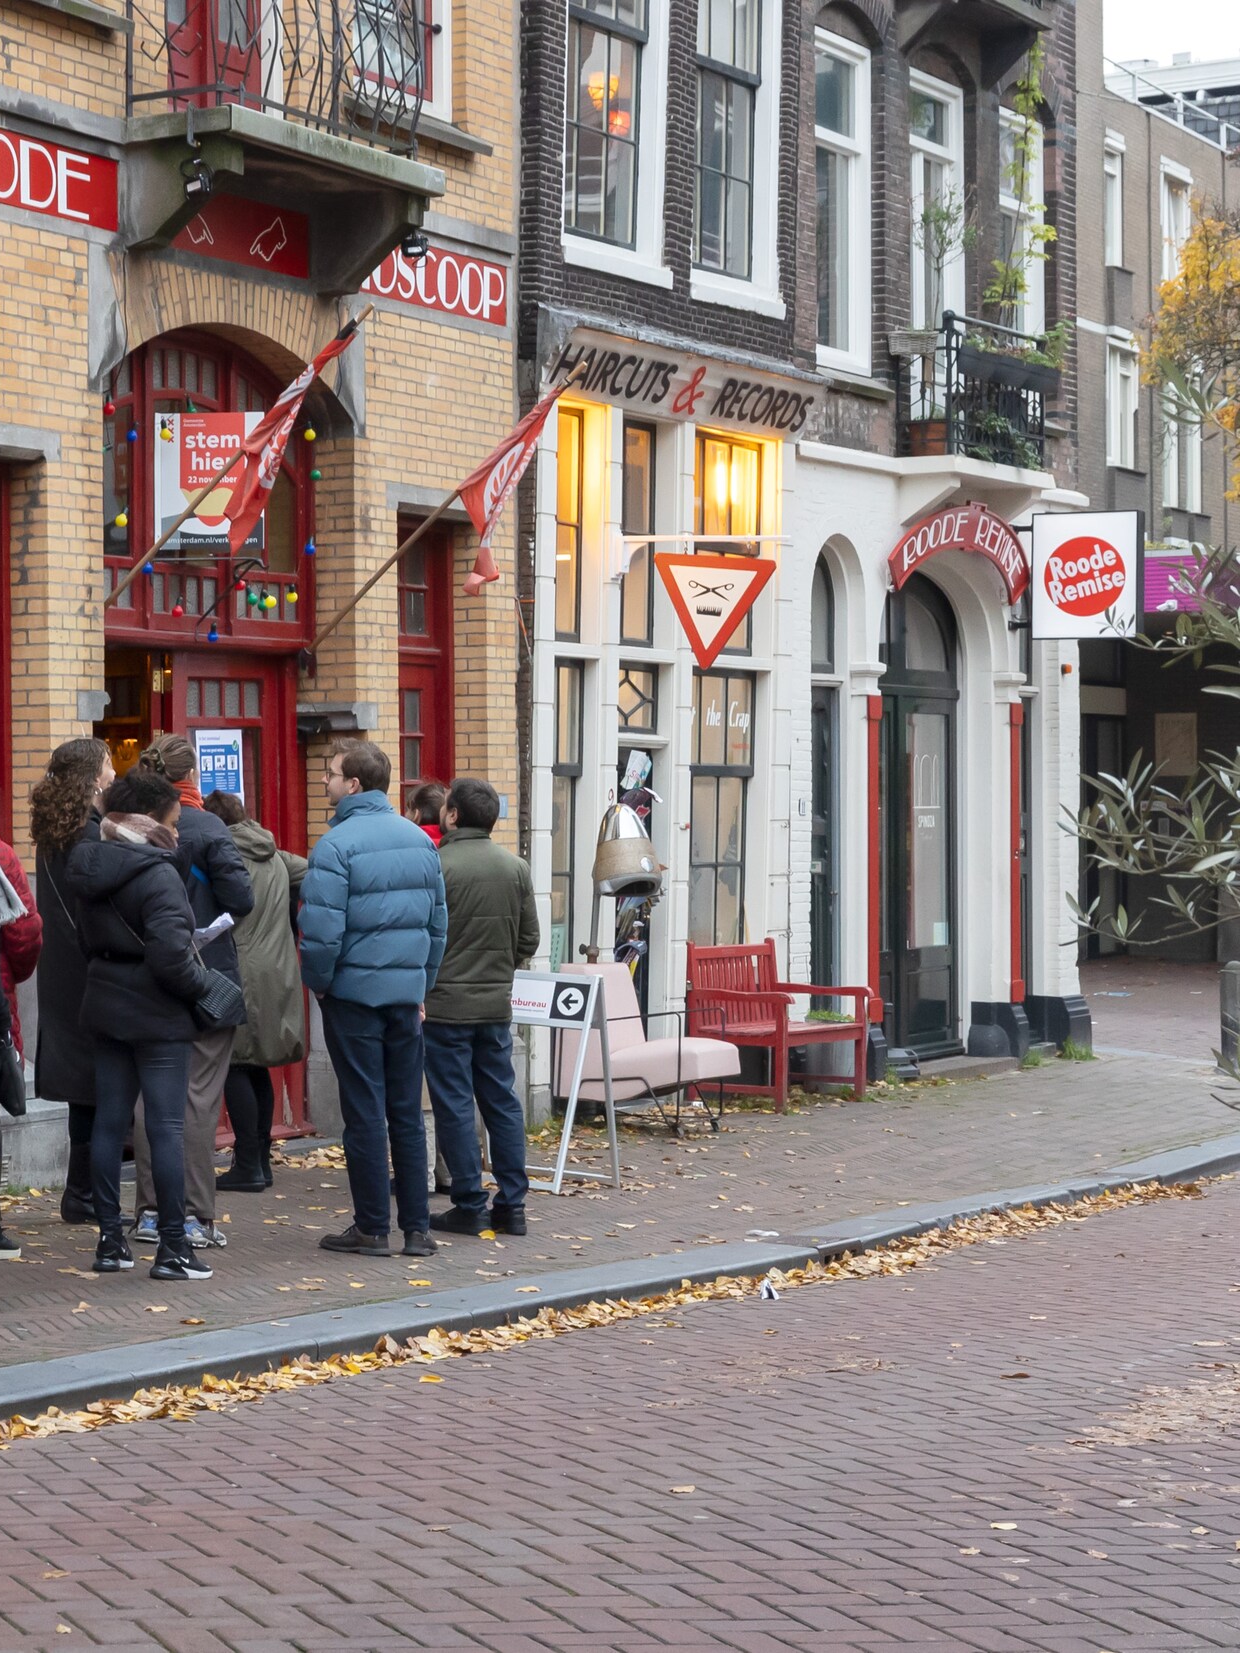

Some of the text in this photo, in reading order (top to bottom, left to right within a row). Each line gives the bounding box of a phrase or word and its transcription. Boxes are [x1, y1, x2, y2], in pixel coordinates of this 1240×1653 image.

[549, 342, 815, 433] HAIRCUTS & RECORDS
[185, 432, 240, 449] stem
[188, 475, 237, 484] 22 novber
[167, 536, 258, 545] amsterdam.nl/verkgen
[903, 512, 1024, 588] ROODE REMISE
[1048, 544, 1117, 582] Roode
[1048, 570, 1126, 605] Remise
[730, 701, 750, 734] Crap
